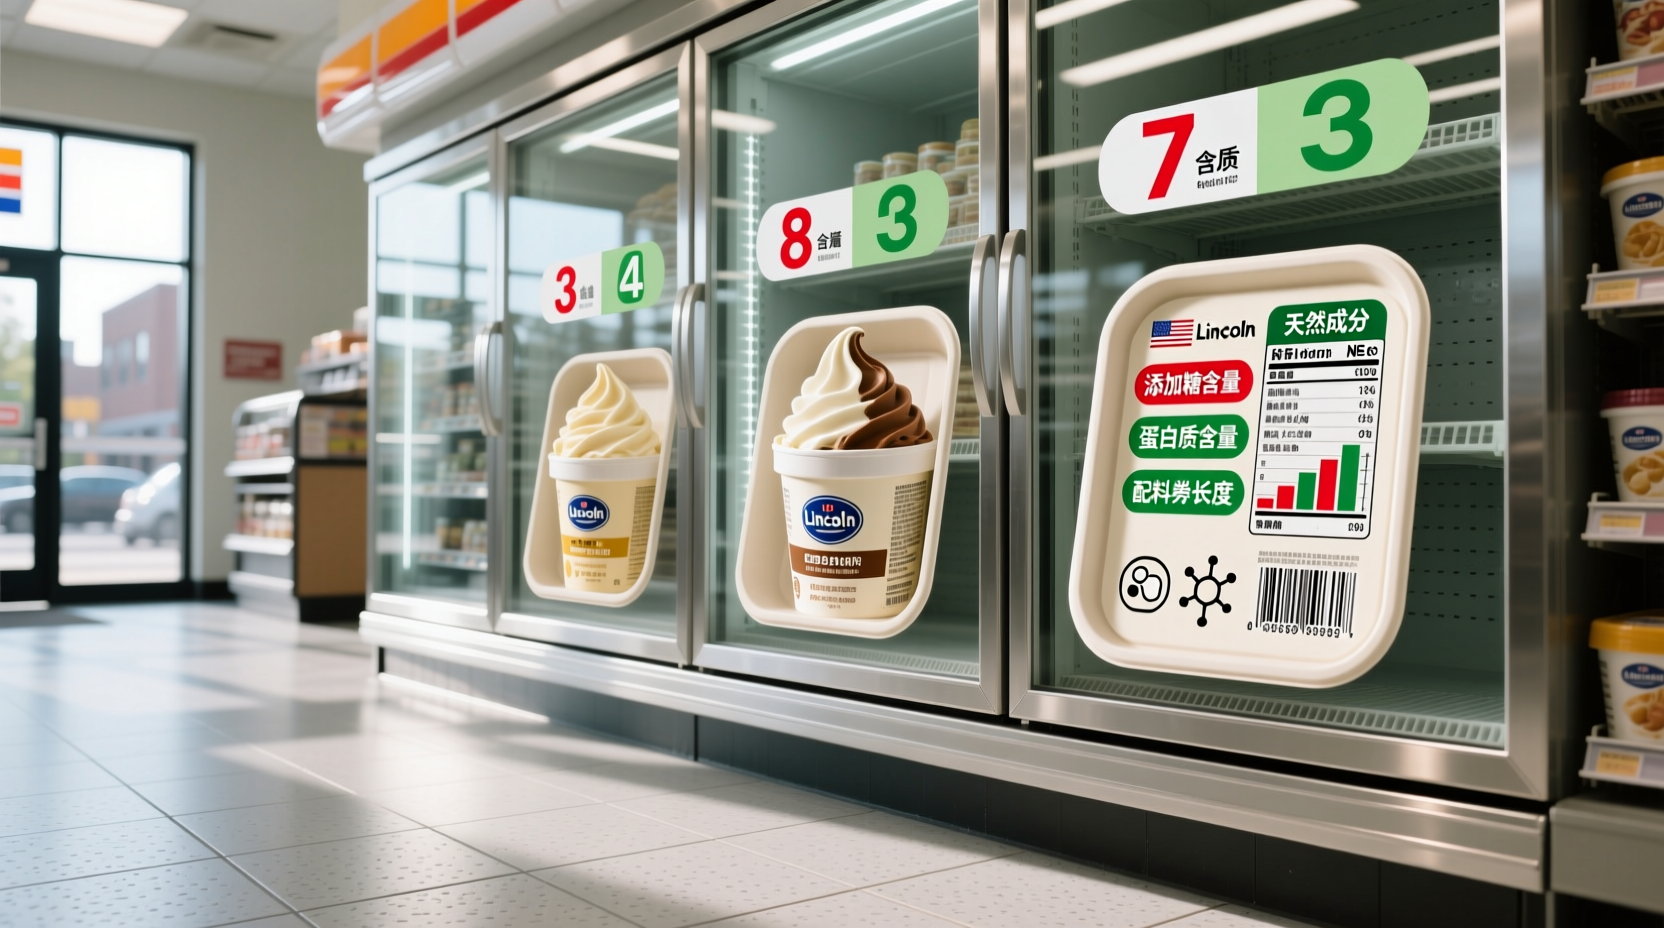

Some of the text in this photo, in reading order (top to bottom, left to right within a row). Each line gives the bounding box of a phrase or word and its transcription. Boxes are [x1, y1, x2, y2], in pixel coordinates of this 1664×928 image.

[1300, 78, 1373, 172] 3
[1142, 113, 1195, 200] 7
[1195, 145, 1240, 175] 含质
[779, 206, 813, 270] 8
[876, 184, 917, 252] 3
[554, 265, 577, 314] 3
[618, 254, 644, 298] 4
[1195, 319, 1256, 341] Lincoln
[1284, 308, 1370, 337] 天然成分
[1143, 369, 1242, 397] 添加糖含量
[1138, 424, 1238, 450] 蛋白质含量
